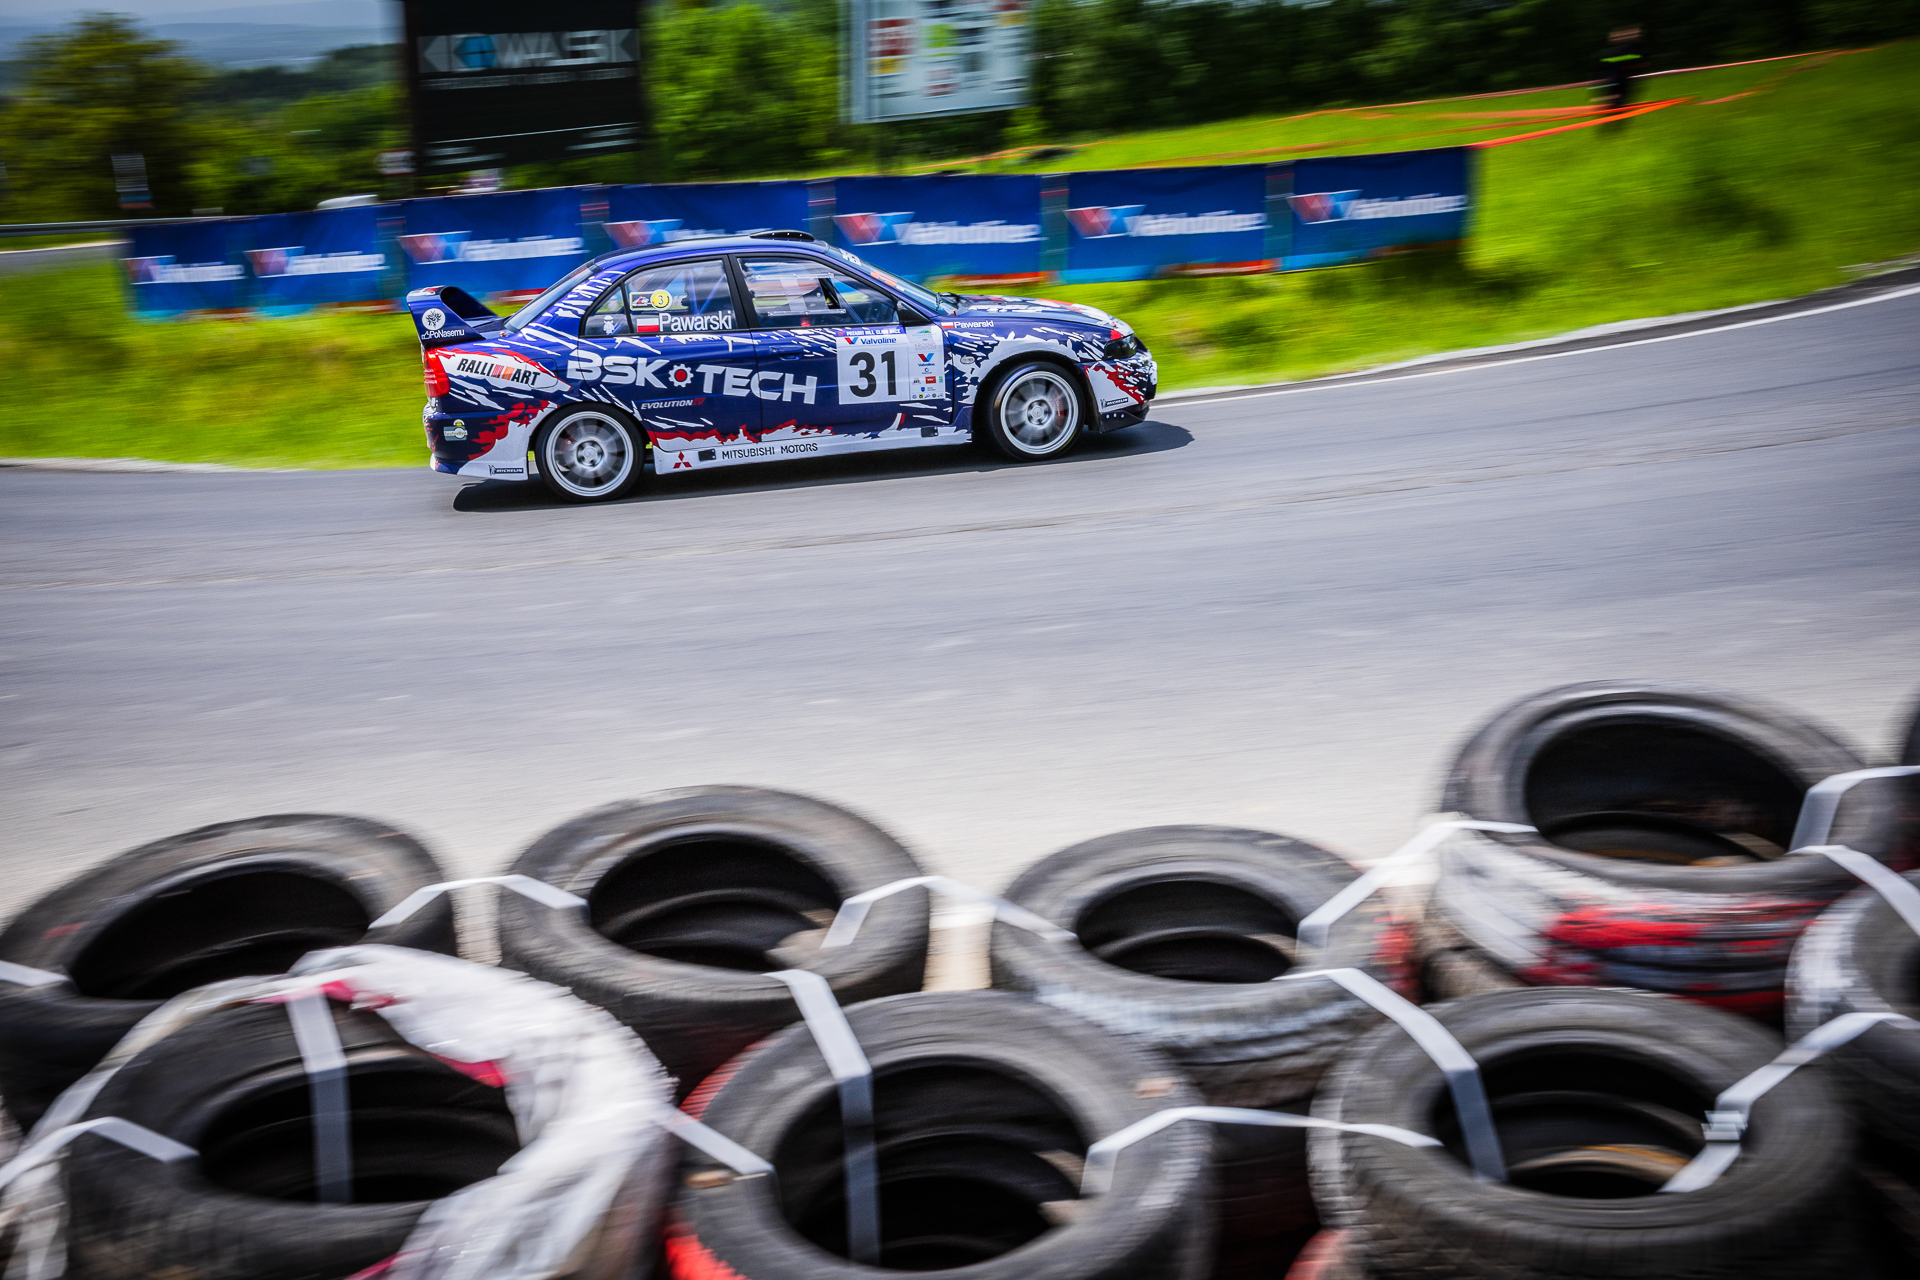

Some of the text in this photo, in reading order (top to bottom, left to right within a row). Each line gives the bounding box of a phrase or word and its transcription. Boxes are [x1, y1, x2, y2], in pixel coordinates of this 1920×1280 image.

[658, 295, 664, 305] 3
[659, 310, 732, 332] Pawarski
[954, 320, 995, 329] Pawarski
[860, 337, 897, 345] Valvoline
[566, 349, 818, 405] BSK TECH
[849, 350, 897, 398] 31
[721, 443, 818, 460] MITSUBISHI MOTORS
